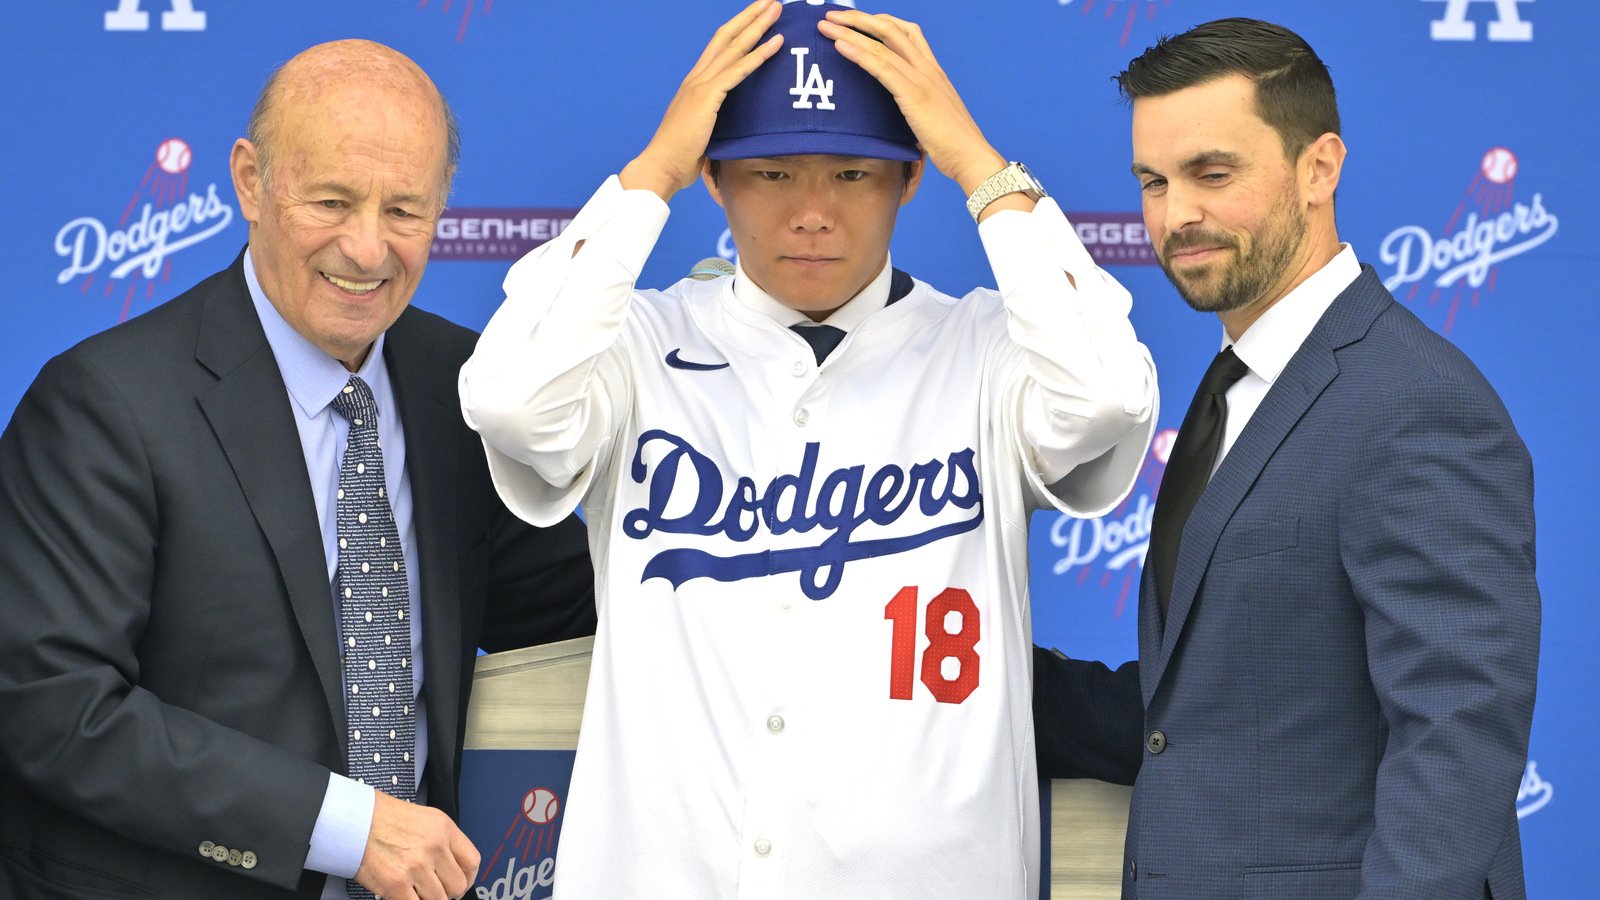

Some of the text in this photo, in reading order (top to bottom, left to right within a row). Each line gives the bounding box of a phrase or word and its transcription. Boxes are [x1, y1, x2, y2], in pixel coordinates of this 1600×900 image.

[789, 47, 836, 111] LA
[54, 183, 233, 285] Dodgers
[1379, 192, 1559, 292] Dodgers
[622, 429, 985, 601] Dodgers
[884, 585, 981, 705] 18
